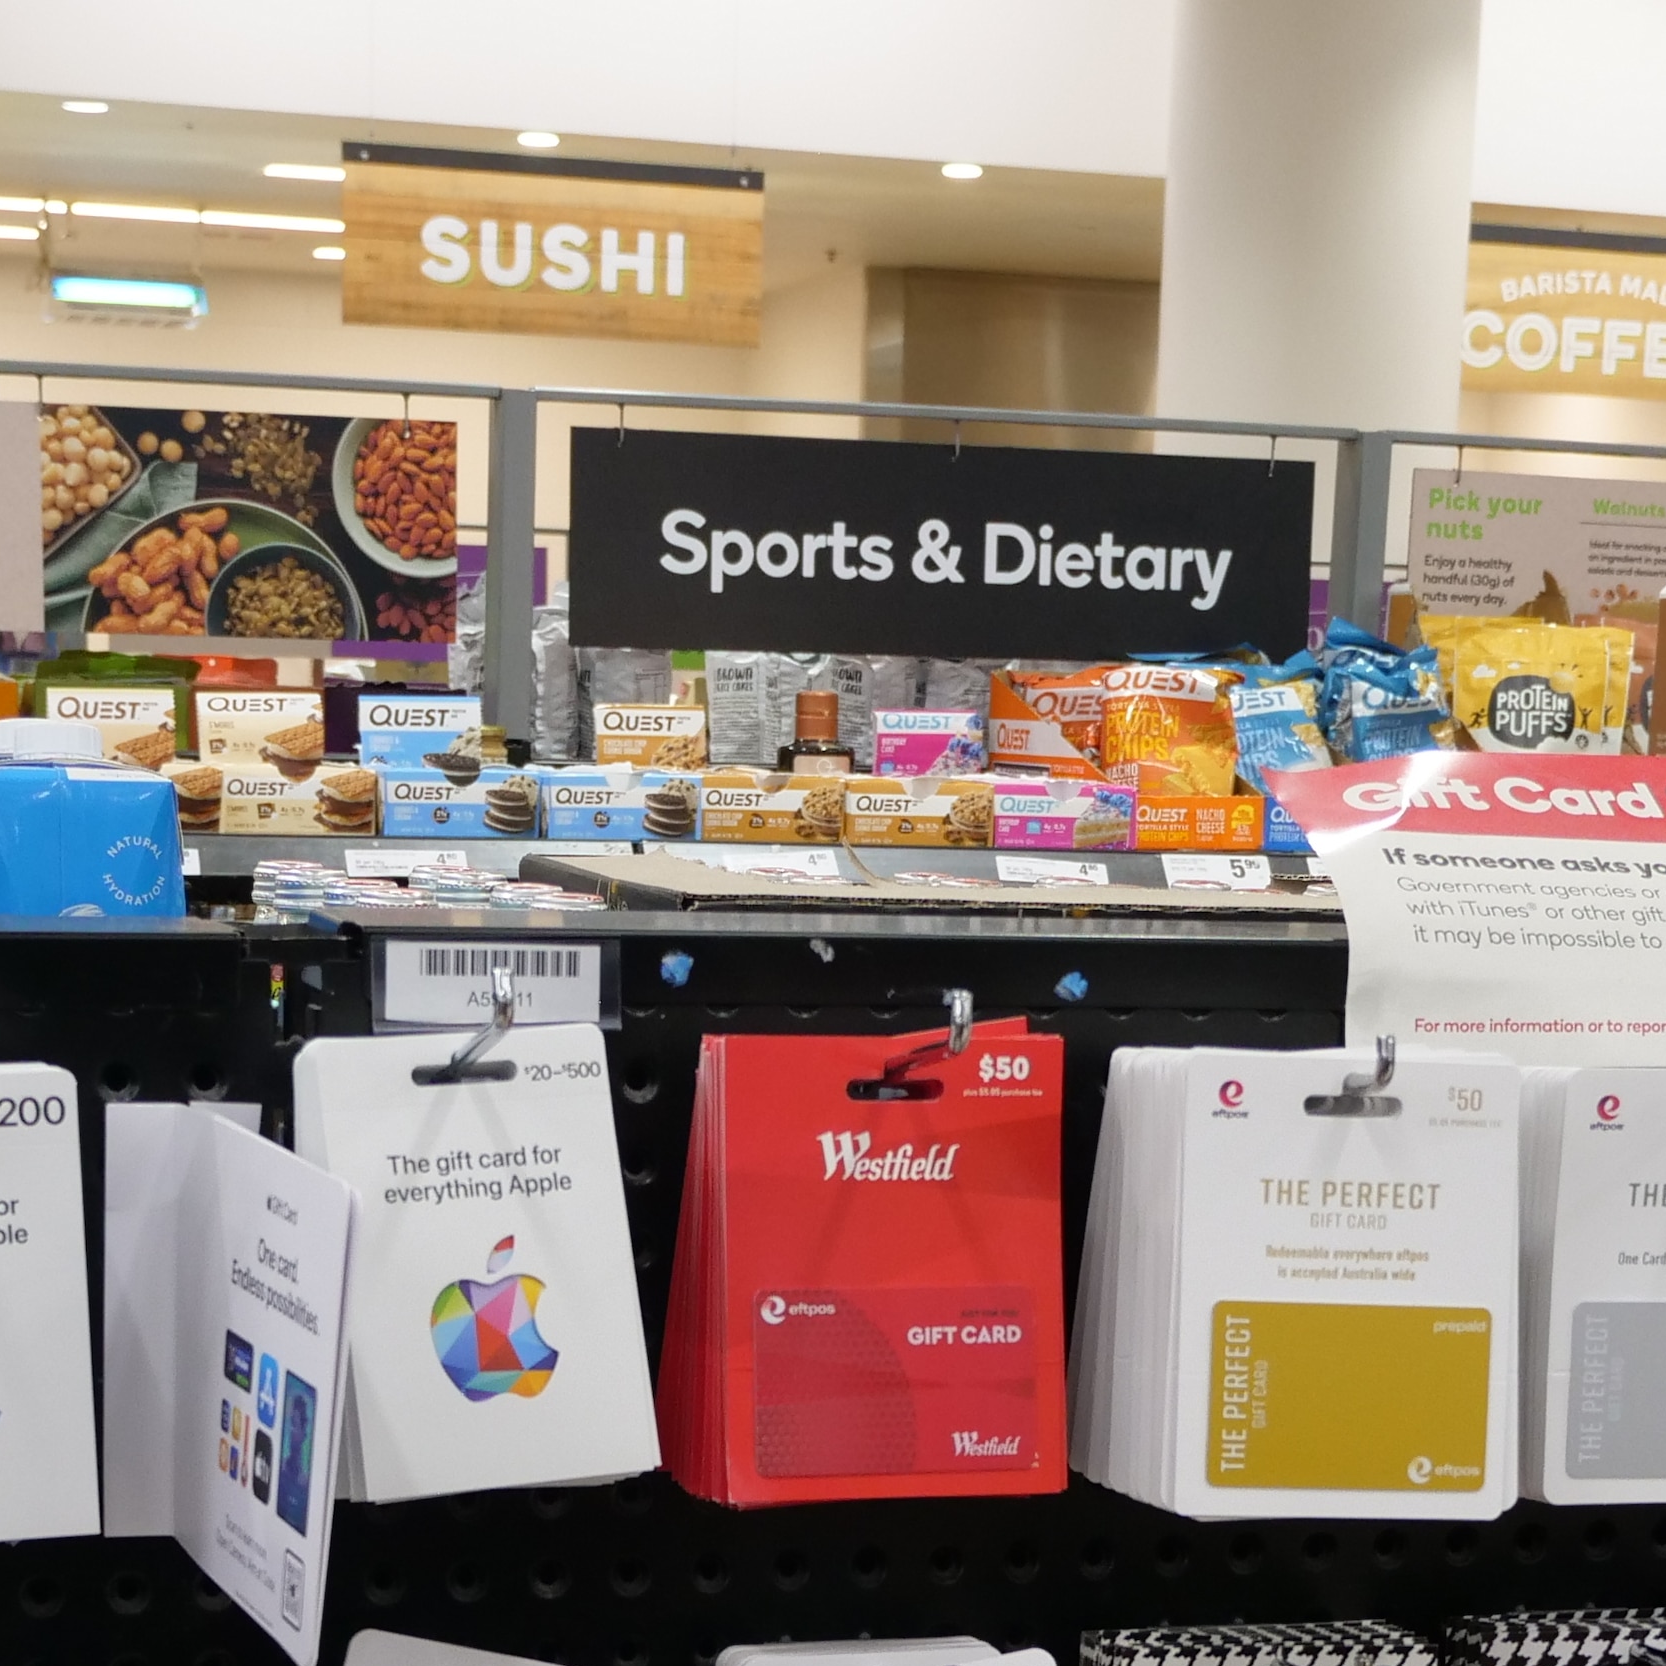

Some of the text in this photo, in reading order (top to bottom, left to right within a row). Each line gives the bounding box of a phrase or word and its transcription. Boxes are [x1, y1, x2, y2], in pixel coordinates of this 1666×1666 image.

[420, 215, 688, 297] SUSHI
[1500, 271, 1612, 303] BARISTA
[1429, 488, 1543, 519] Pick your
[1426, 521, 1483, 540] nuts
[660, 509, 1232, 611] Sports & Dietary
[1424, 555, 1512, 572] Enjoy a healthy
[1423, 573, 1514, 589] handful (30g) of
[1423, 593, 1507, 607] nuts every day.
[1496, 682, 1570, 714] PROTEIN
[602, 711, 677, 734] QUEST
[1495, 709, 1569, 739] PUFFS
[1342, 778, 1491, 812] Gift
[1494, 777, 1664, 819] Card
[1382, 848, 1406, 865] If
[1413, 854, 1555, 871] someone
[1561, 858, 1631, 874] asks
[1415, 1018, 1440, 1033] For
[1444, 1022, 1485, 1033] more
[1490, 1019, 1584, 1033] information
[1588, 1022, 1603, 1033] or
[1607, 1020, 1623, 1033] to
[979, 1054, 1030, 1083] $50
[817, 1131, 960, 1182] Westfield
[1618, 1252, 1638, 1265] One
[788, 1302, 836, 1316] eftpos
[907, 1325, 1021, 1346] GIFT CARD
[951, 1430, 1022, 1458] Westfield
